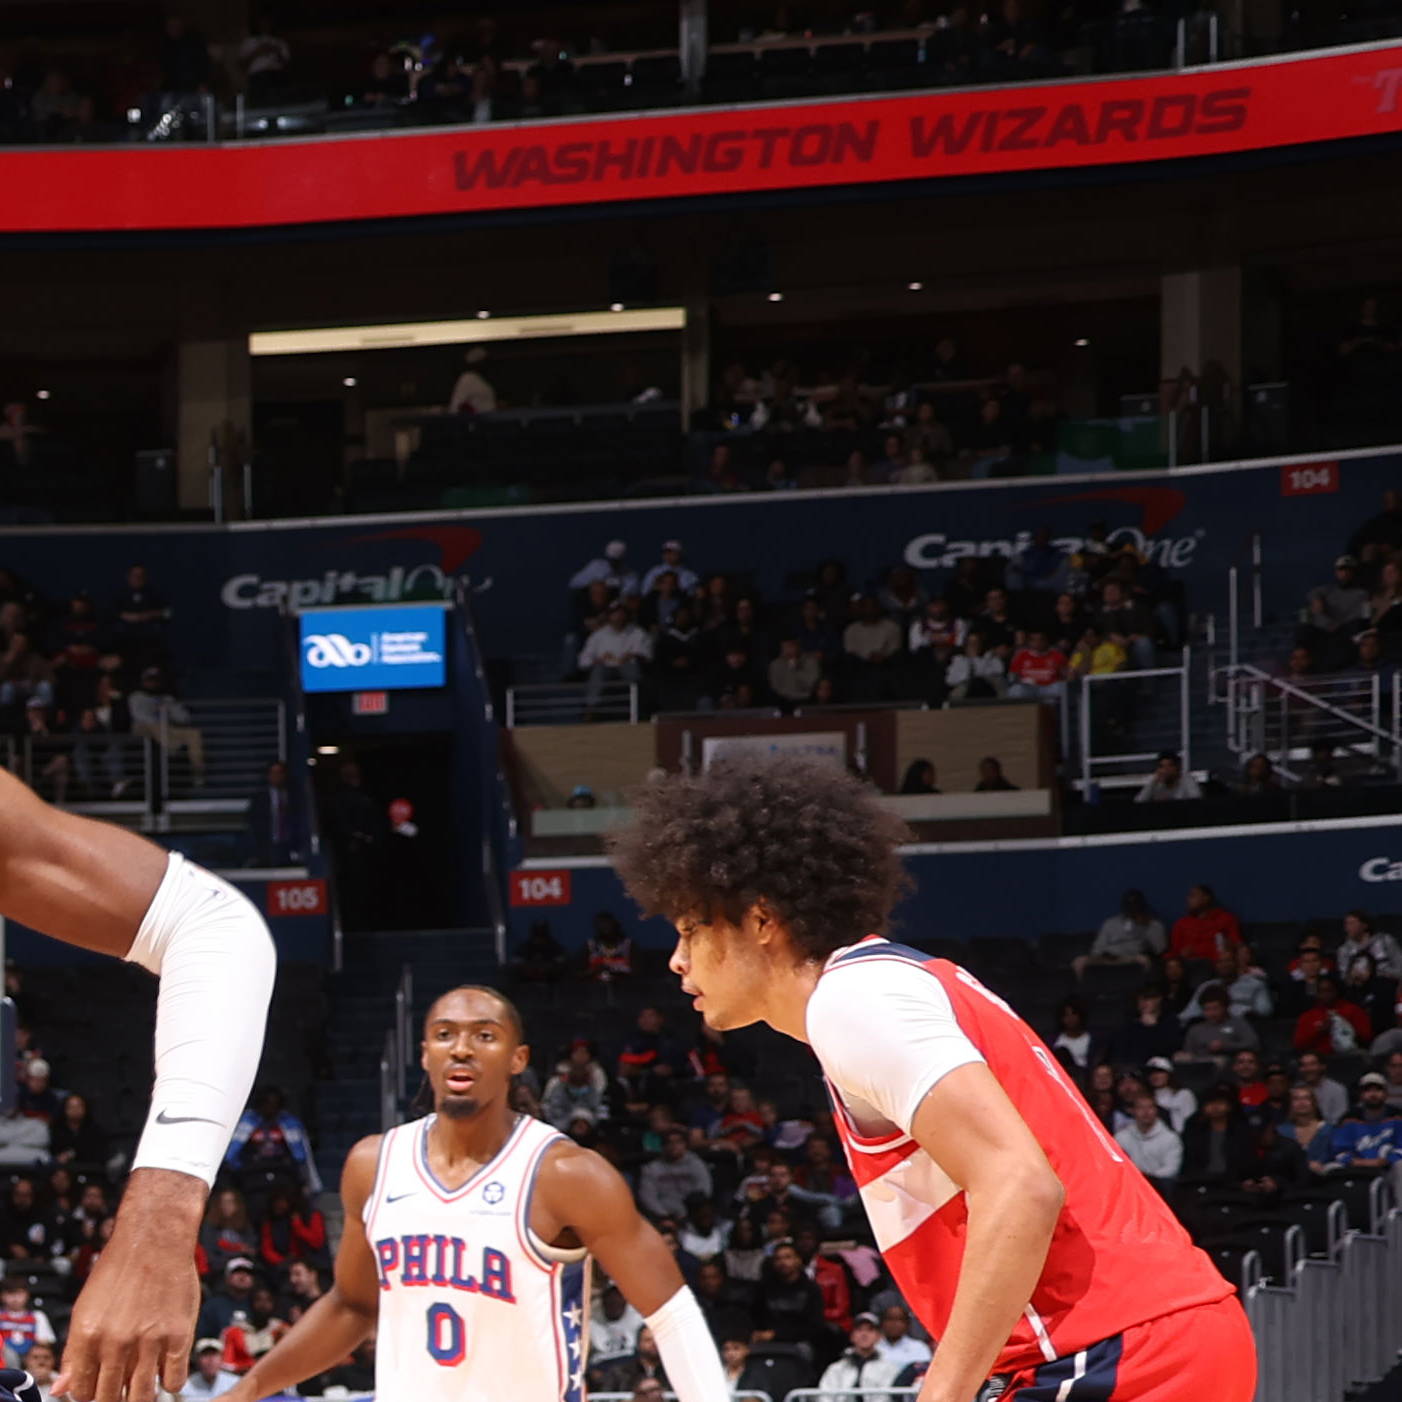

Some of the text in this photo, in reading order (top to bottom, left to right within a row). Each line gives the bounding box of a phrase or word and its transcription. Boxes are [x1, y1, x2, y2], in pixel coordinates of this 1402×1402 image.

[453, 88, 1252, 192] WASHINGTON WIZARDS
[1286, 468, 1331, 490] 104
[275, 885, 319, 911] 105
[518, 876, 565, 901] 104
[376, 1233, 517, 1305] PHILA
[426, 1302, 466, 1367] 0
